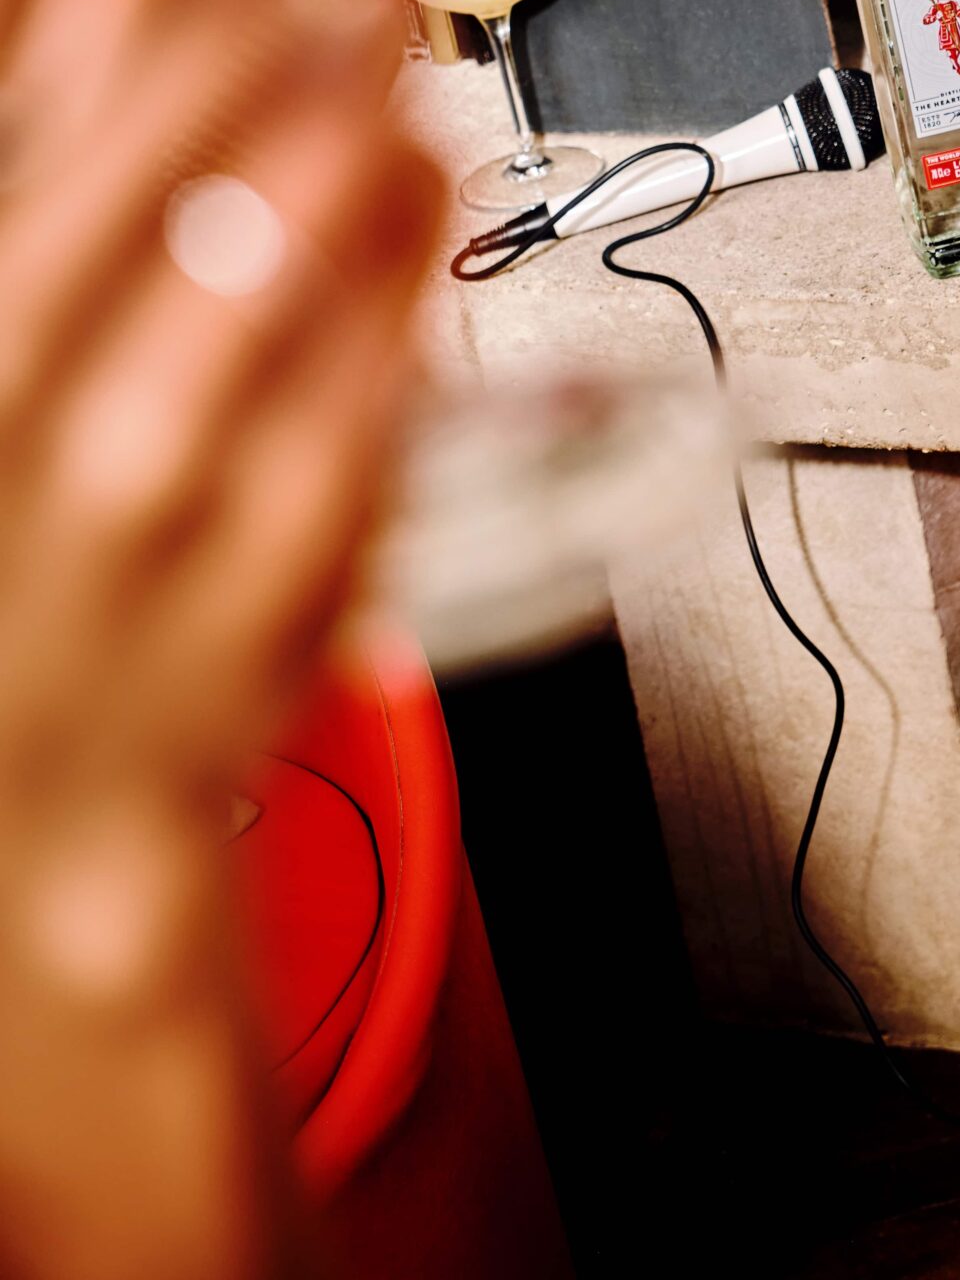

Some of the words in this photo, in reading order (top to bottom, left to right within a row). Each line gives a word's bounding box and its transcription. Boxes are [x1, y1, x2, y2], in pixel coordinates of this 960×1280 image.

[915, 103, 932, 112] THE
[934, 96, 960, 107] HEART
[923, 120, 941, 129] 1820
